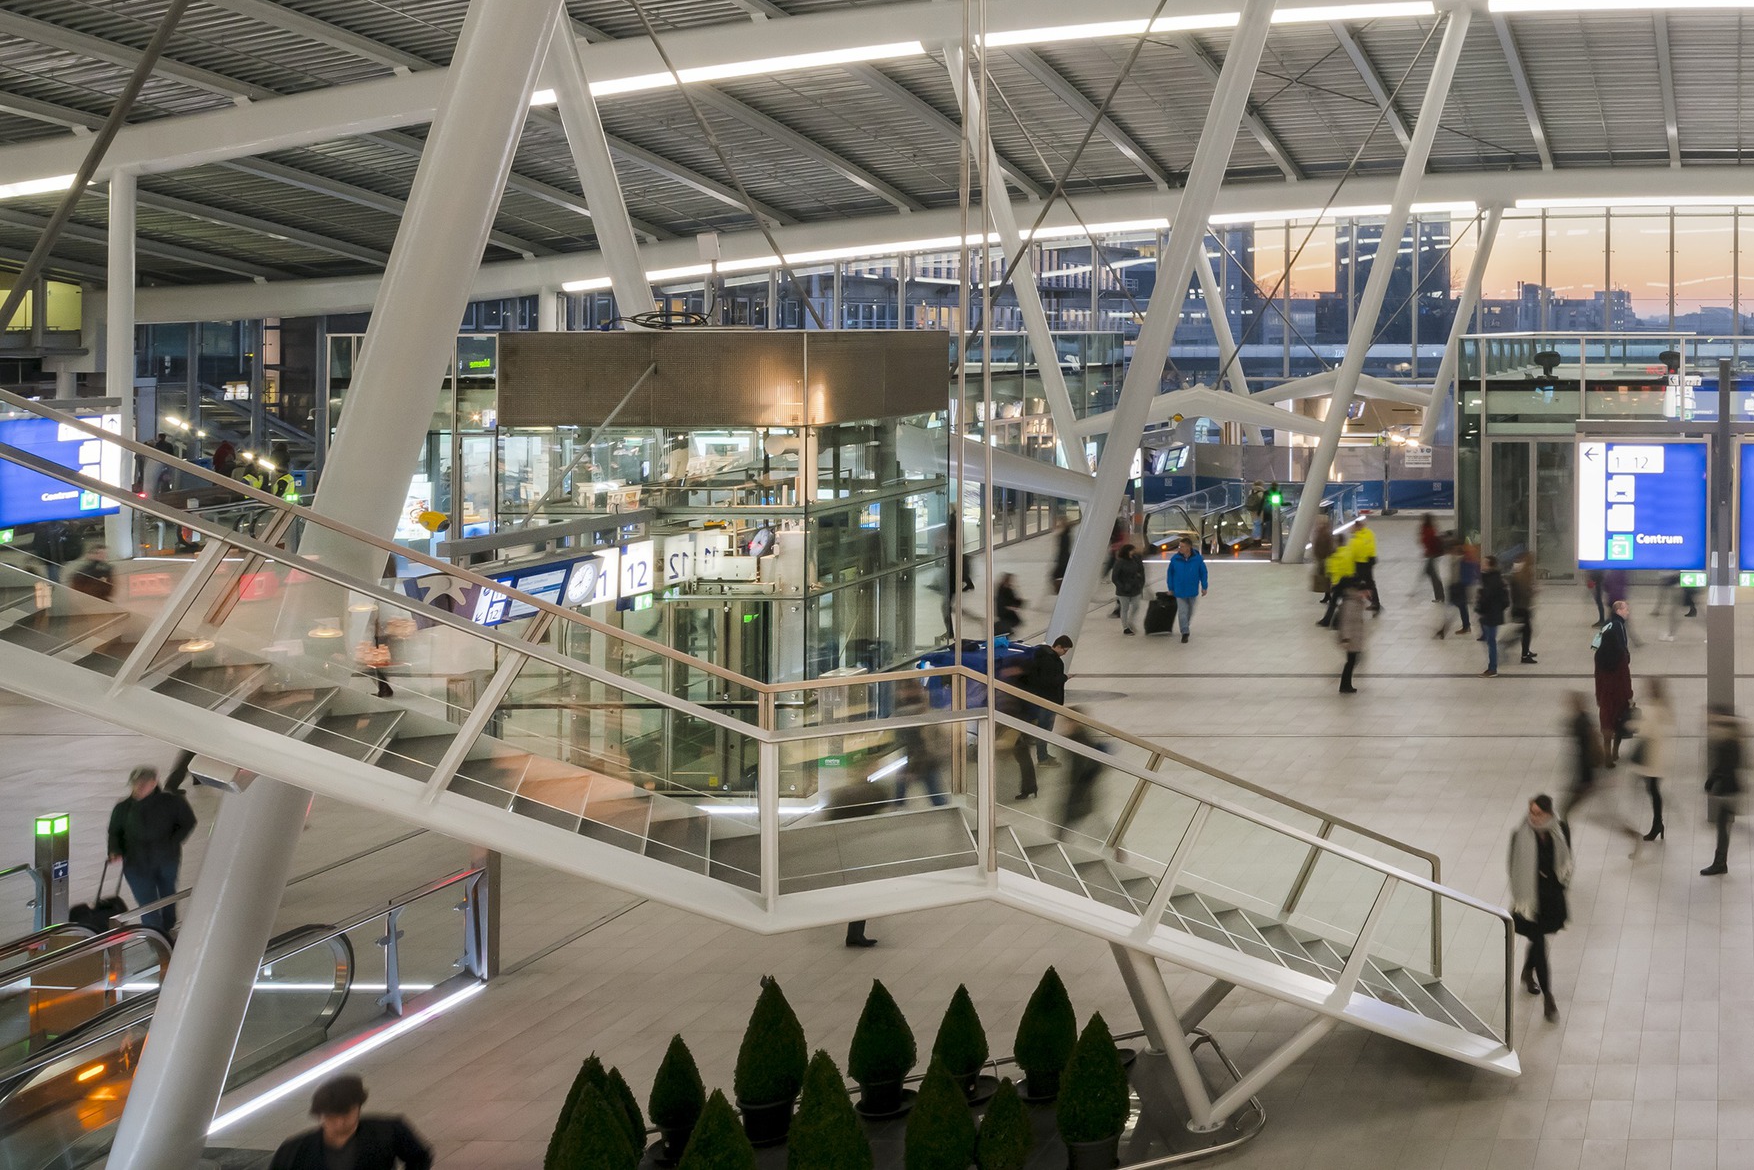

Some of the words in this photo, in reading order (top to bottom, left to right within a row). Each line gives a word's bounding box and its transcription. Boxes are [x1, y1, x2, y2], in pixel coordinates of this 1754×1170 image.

[1633, 456, 1650, 470] 12
[1636, 533, 1684, 545] Centrum
[626, 560, 648, 590] 12
